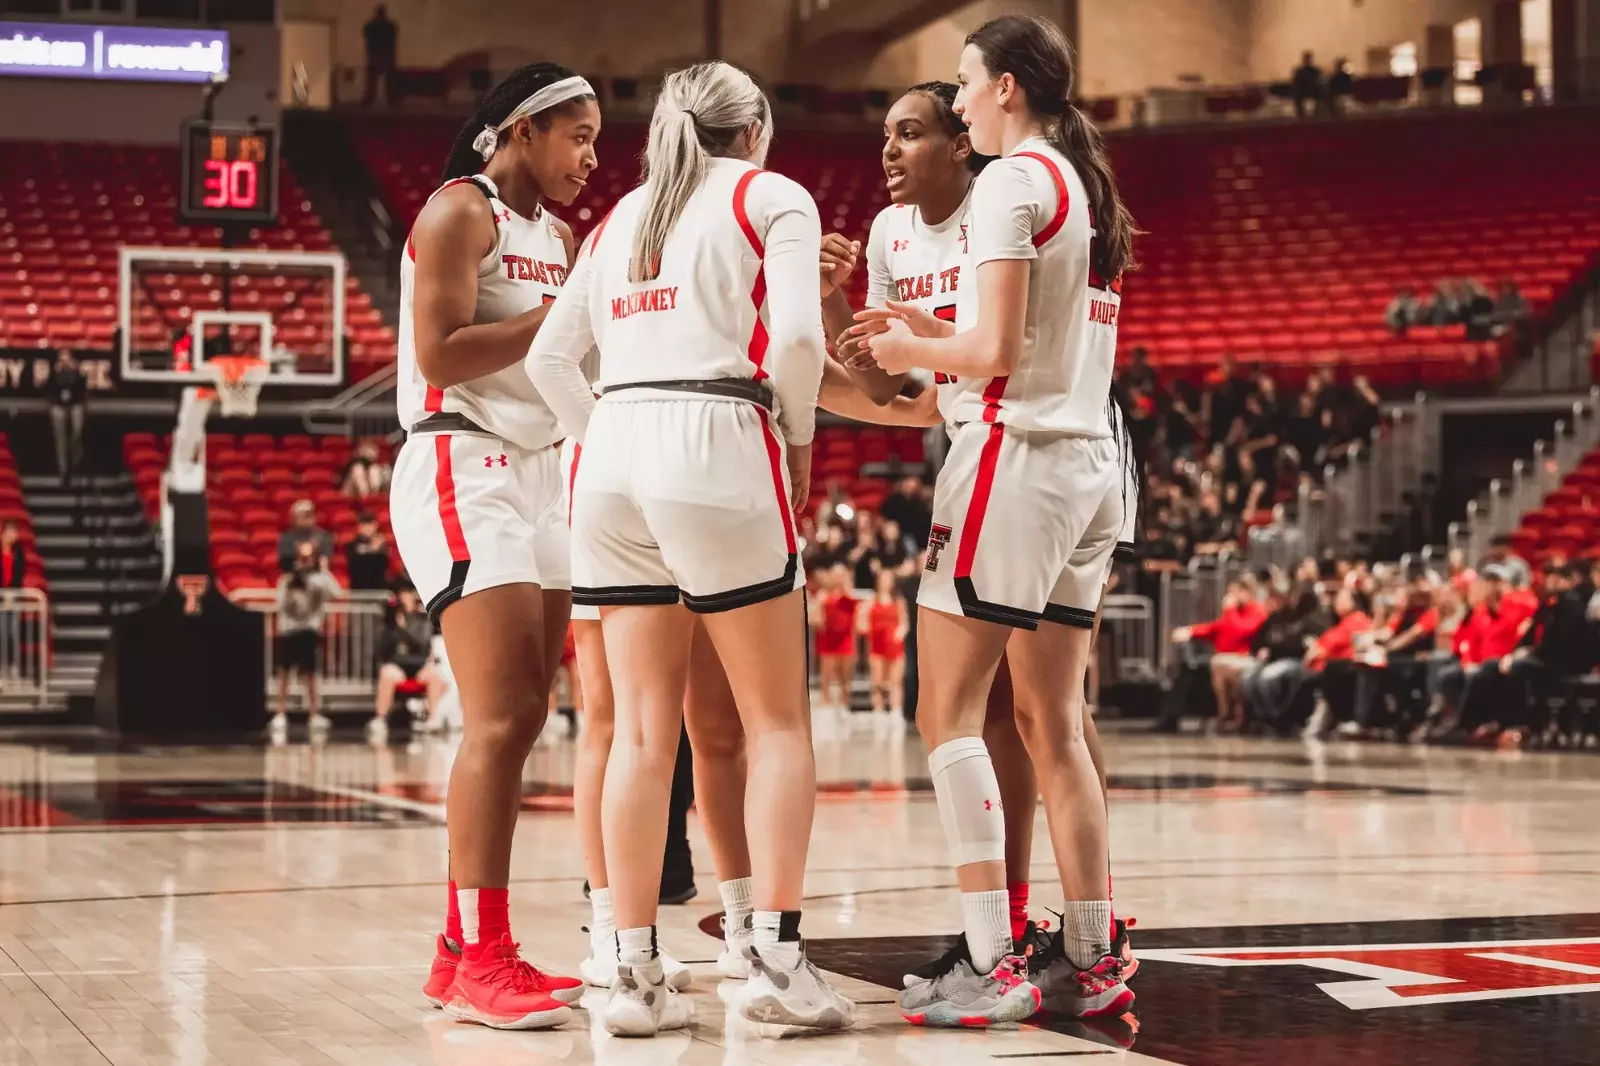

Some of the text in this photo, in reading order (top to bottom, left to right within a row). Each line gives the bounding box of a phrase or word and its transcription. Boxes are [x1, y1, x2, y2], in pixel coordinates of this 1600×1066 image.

[203, 160, 257, 208] 30
[502, 254, 549, 285] TEXAS
[1088, 299, 1118, 326] MAUP
